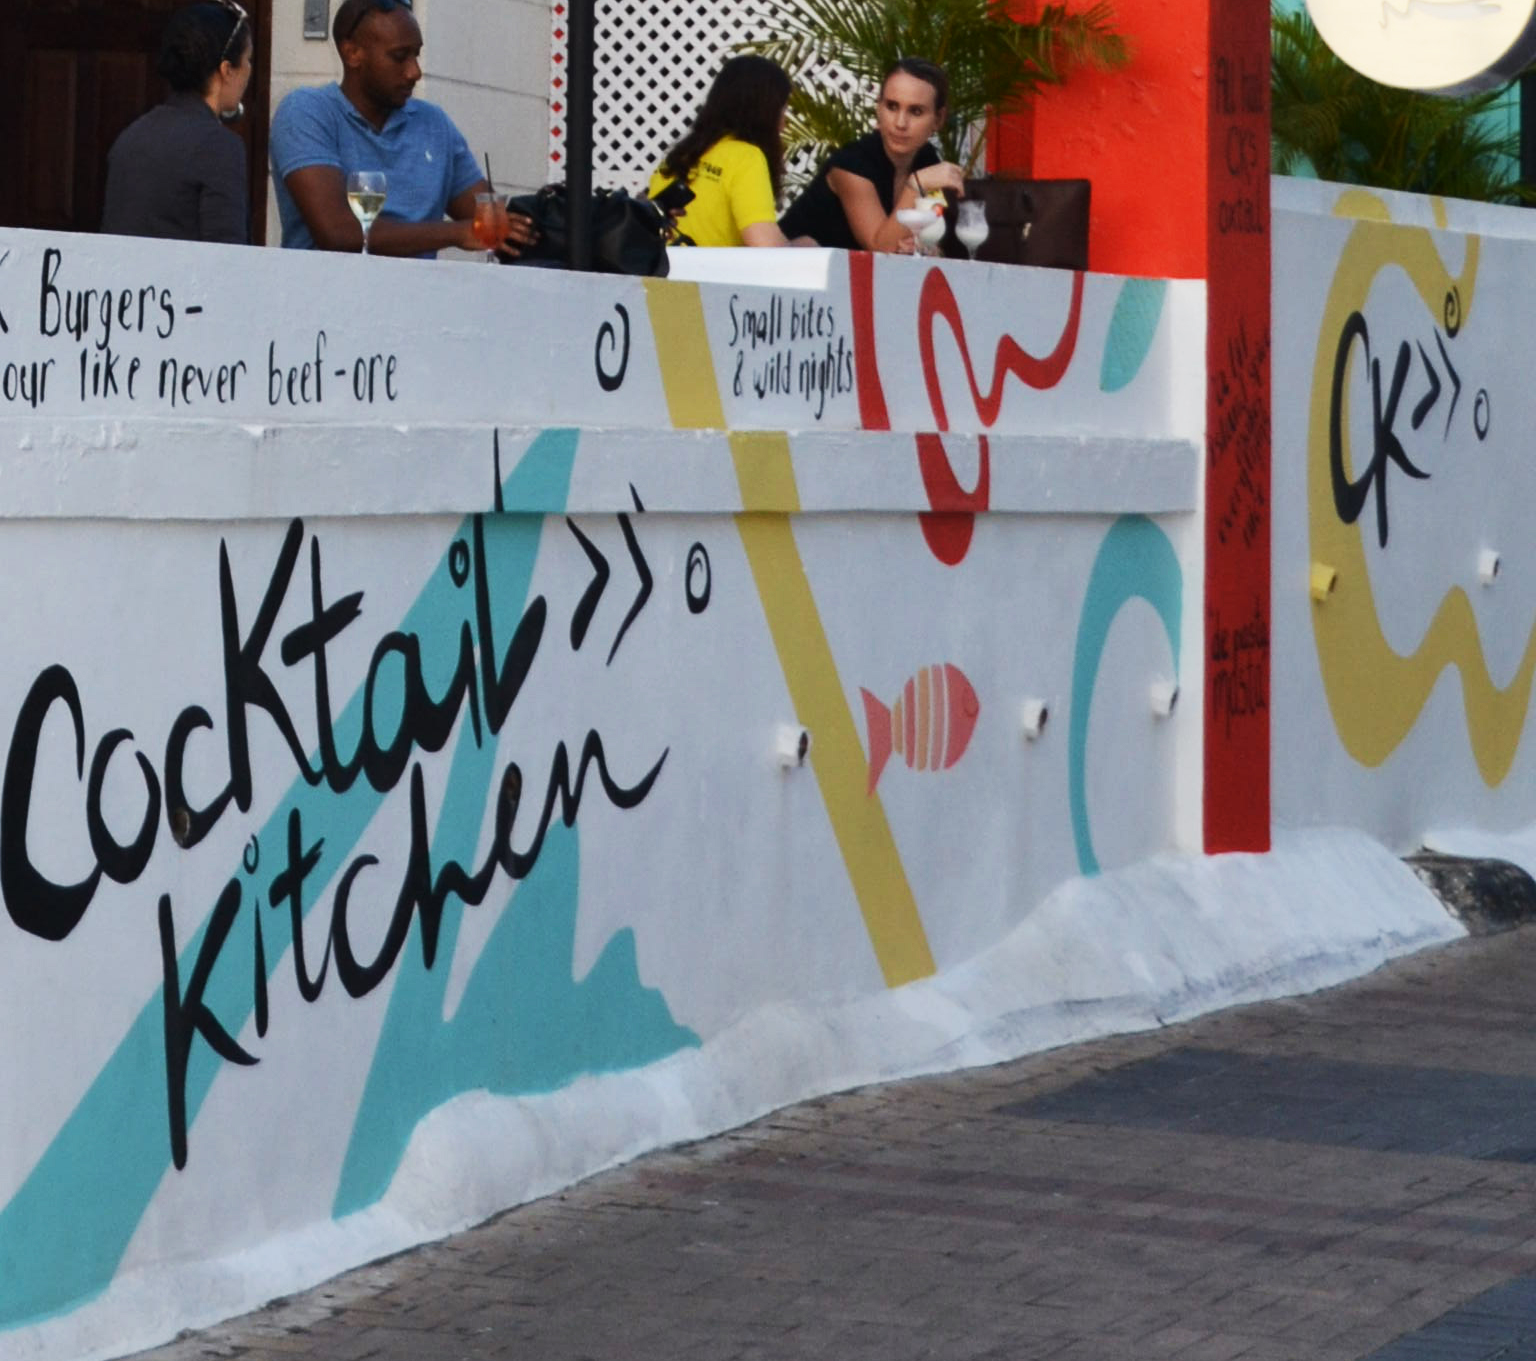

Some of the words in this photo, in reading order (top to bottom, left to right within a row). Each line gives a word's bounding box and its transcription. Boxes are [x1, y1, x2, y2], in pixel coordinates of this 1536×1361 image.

[728, 292, 782, 350] Small
[791, 296, 835, 342] bites
[80, 346, 141, 402] like
[158, 352, 247, 408] never
[753, 348, 792, 400] wild
[799, 335, 854, 421] nights
